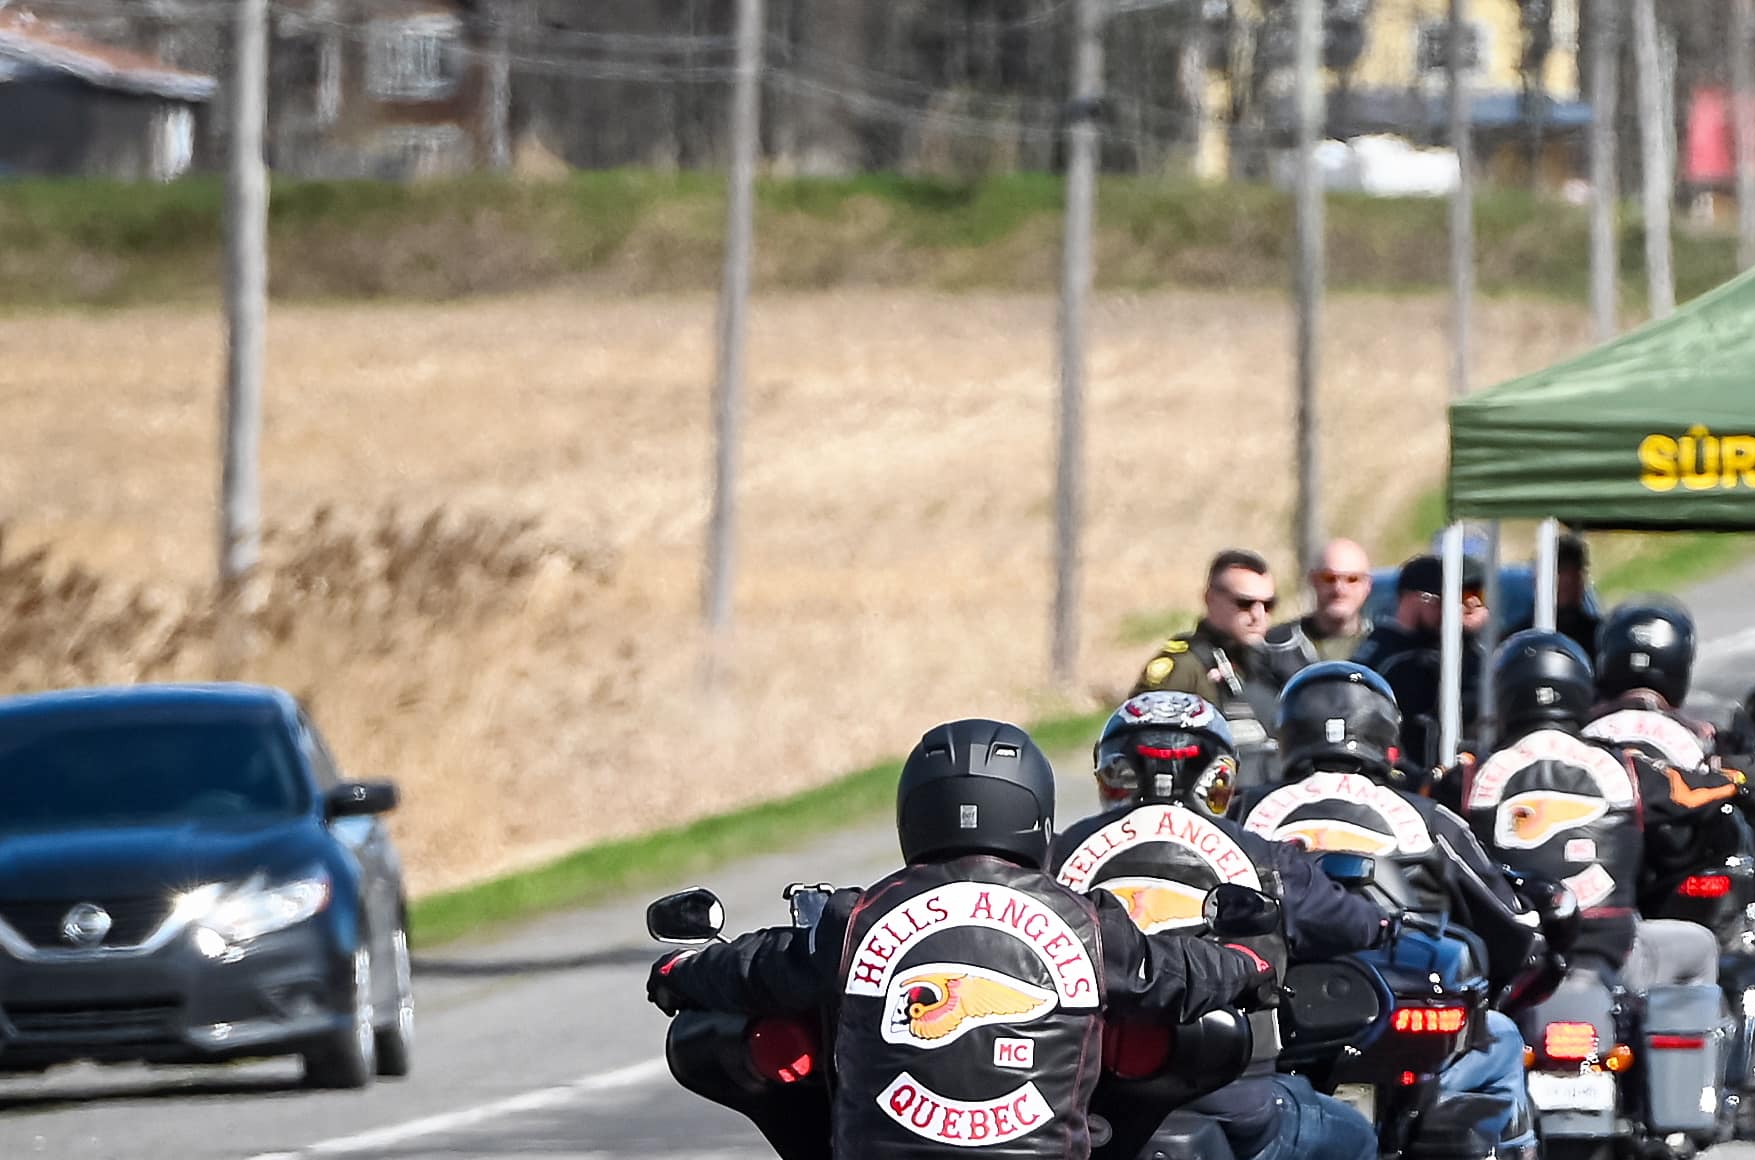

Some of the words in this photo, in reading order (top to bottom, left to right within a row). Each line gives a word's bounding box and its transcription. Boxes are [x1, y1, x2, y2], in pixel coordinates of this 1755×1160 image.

[1155, 811, 1249, 881] ANGEL
[854, 896, 949, 988] HELLS
[969, 891, 1092, 999] ANGELS
[999, 1043, 1029, 1062] MC
[889, 1084, 1041, 1141] QUEBEC
